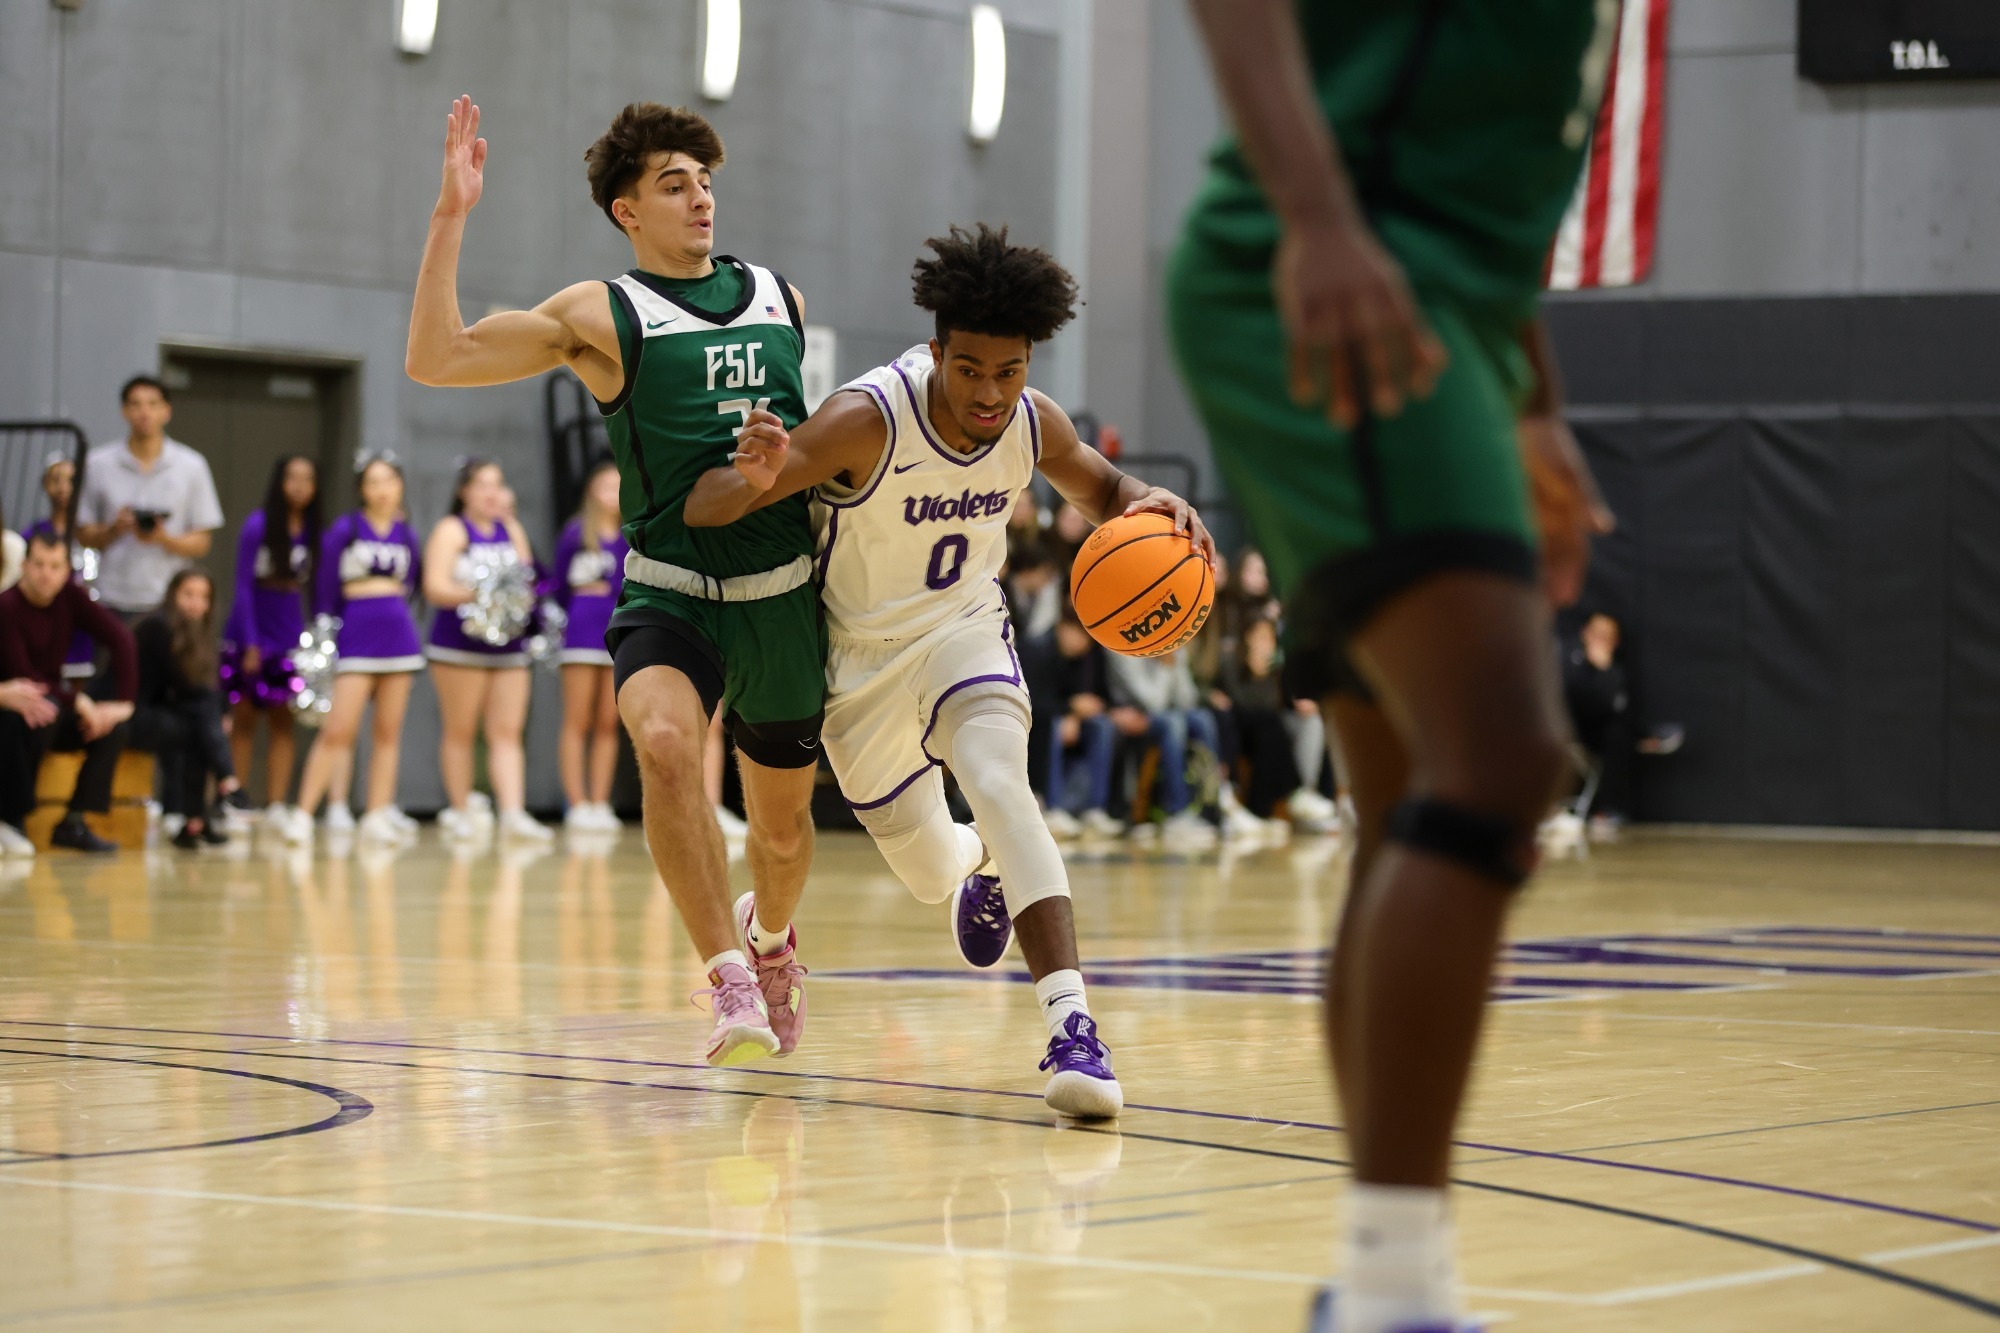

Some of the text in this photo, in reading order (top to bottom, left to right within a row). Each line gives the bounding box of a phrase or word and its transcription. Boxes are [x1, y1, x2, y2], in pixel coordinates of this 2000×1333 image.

[704, 341, 766, 391] FSC
[901, 487, 1013, 527] Violets
[924, 532, 971, 592] 0
[1119, 593, 1181, 643] NCAA
